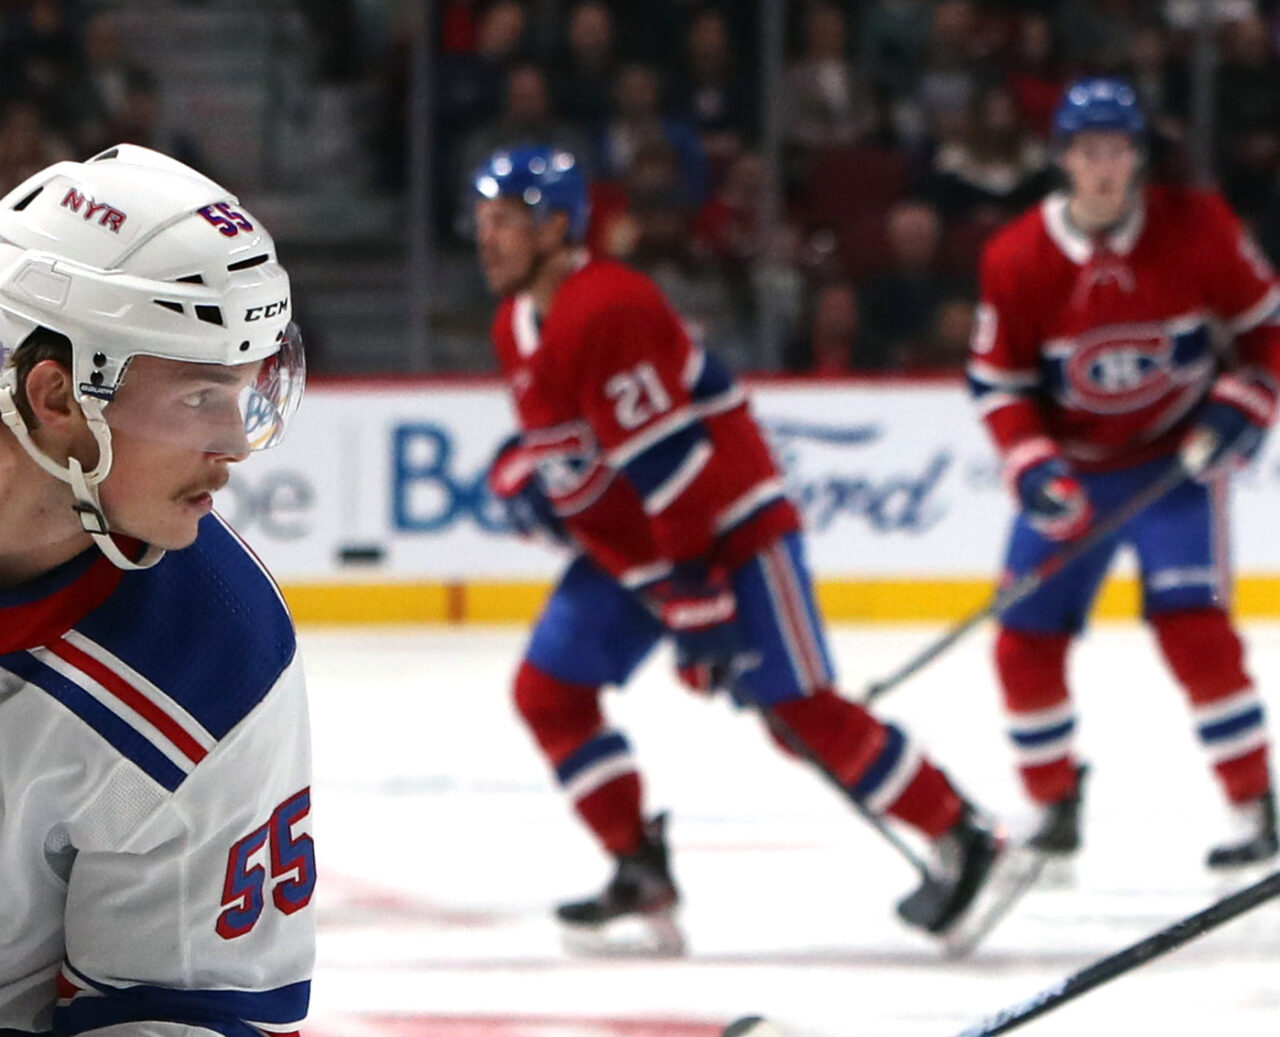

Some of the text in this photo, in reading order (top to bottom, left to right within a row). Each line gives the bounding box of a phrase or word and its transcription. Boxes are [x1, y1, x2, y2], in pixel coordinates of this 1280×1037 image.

[60, 187, 127, 234] NYR
[197, 202, 253, 238] 55
[244, 299, 287, 322] CCM
[604, 361, 673, 431] 21
[215, 785, 318, 940] 55
